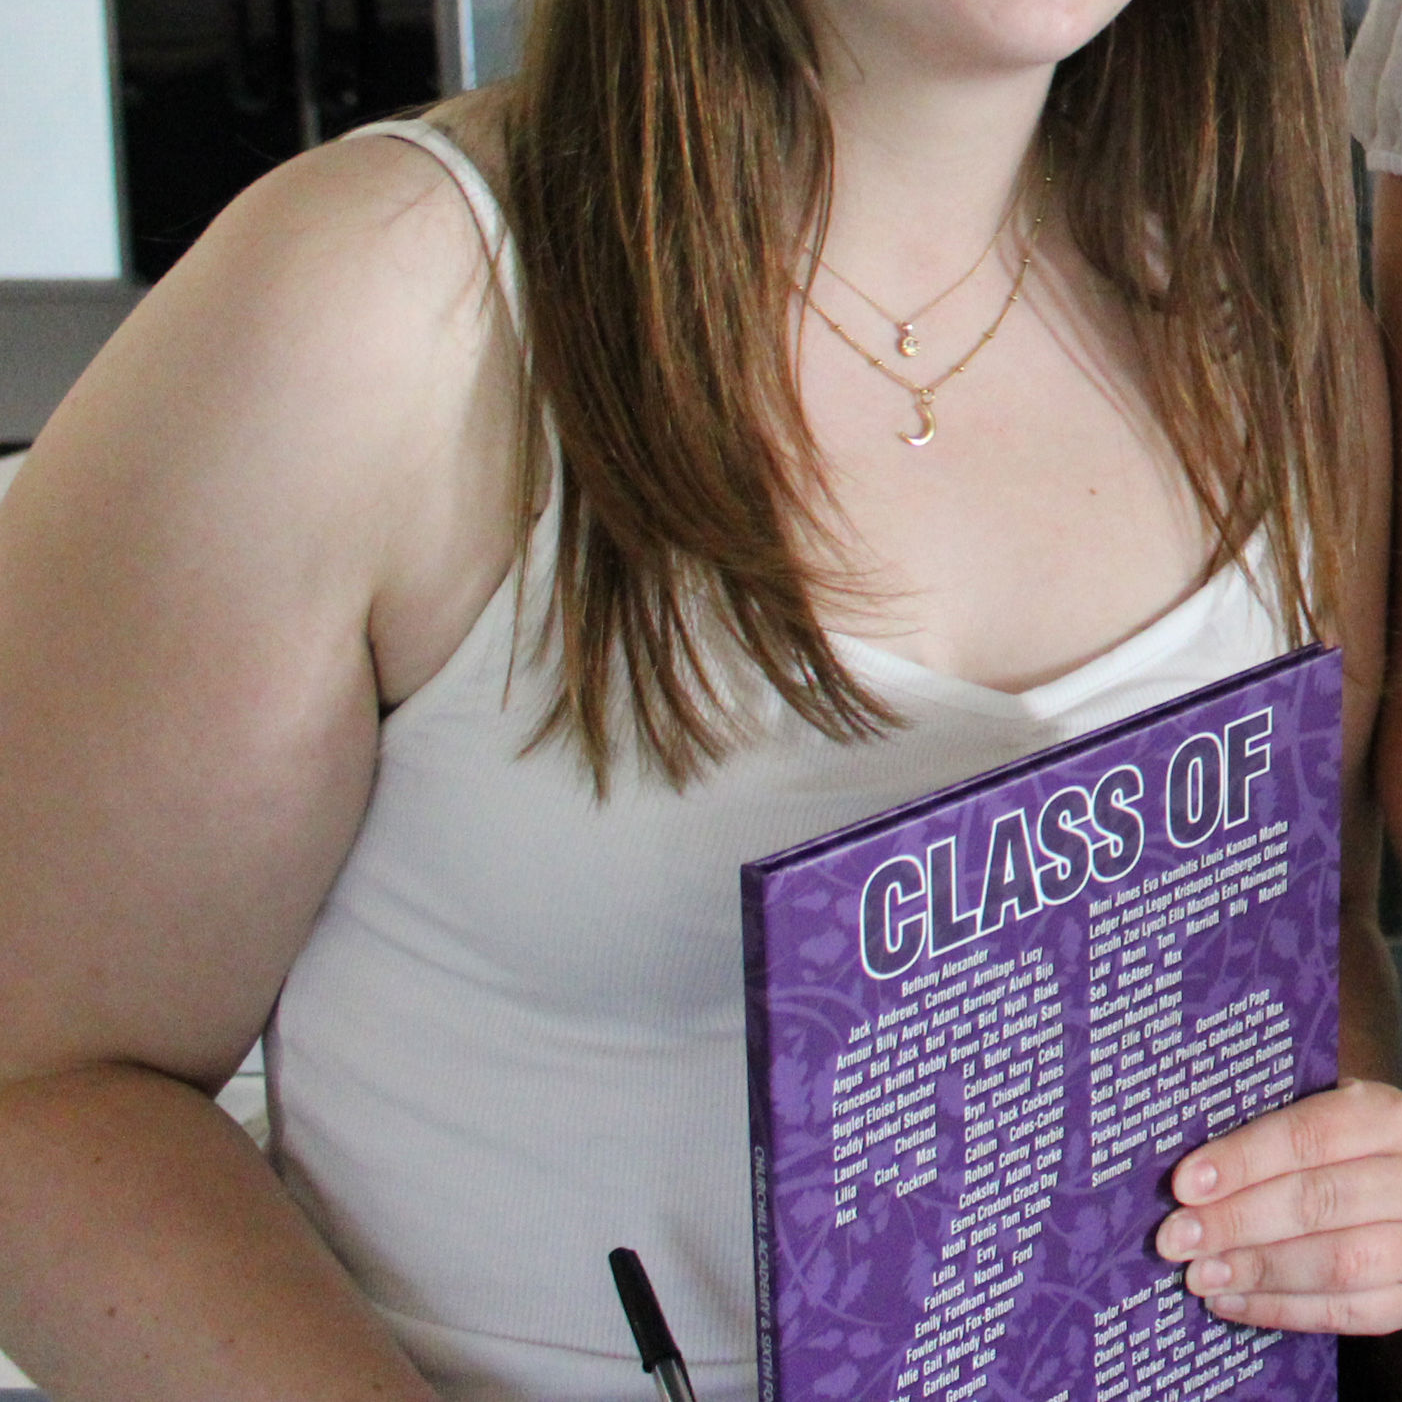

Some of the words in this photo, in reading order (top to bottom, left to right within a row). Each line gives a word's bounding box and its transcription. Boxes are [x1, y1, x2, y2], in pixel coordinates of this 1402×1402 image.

[860, 765, 1143, 979] CLASS
[1166, 707, 1273, 849] OF
[1114, 885, 1140, 906] Jones
[1143, 877, 1158, 894] Eva
[1200, 847, 1223, 868] Louis
[1259, 820, 1288, 841] Martha
[1089, 916, 1120, 939] Ledger
[1121, 905, 1143, 923] Anna
[1263, 840, 1288, 860] Oliver
[1089, 936, 1121, 960] Lincoln
[1123, 927, 1139, 944] Zoe
[1141, 915, 1166, 936] Lynch
[1168, 907, 1184, 924] Ella
[1221, 883, 1238, 899] Erin
[901, 970, 939, 997] Bethany
[941, 948, 988, 979] Alexander
[1089, 961, 1110, 981] Luke
[1121, 945, 1146, 966] Mann
[1156, 932, 1175, 949] Tom
[1229, 898, 1248, 917] Billy
[848, 1019, 870, 1043] Jack
[877, 1001, 918, 1030] Andrews
[924, 980, 966, 1008] Cameron
[973, 958, 1014, 987] Armitage
[1020, 946, 1042, 966] Lucy
[1089, 982, 1107, 1002] Seb
[1164, 949, 1181, 967] Max
[1089, 994, 1130, 1022] McCarthy
[1131, 983, 1153, 1002] Jude
[1159, 990, 1182, 1009] Maya
[832, 1070, 862, 1095] Angus
[870, 1055, 889, 1077] Bird
[896, 1044, 918, 1065] Jack
[925, 1031, 944, 1052] Bird
[952, 1021, 971, 1040] Tom
[978, 1007, 997, 1028] Bird
[1033, 981, 1058, 1003] Blake
[832, 1084, 881, 1117] Francesca
[917, 1054, 947, 1077] Bobby
[950, 1039, 979, 1063] Brown
[982, 1030, 999, 1048] Zac
[1002, 1013, 1037, 1038] Buckley
[1041, 1001, 1061, 1020] Sam
[836, 1044, 872, 1071] Armour
[876, 1033, 897, 1052] Billy
[901, 1019, 928, 1041] Avery
[931, 1005, 959, 1027] Adam
[962, 984, 1005, 1013] Barringer
[1089, 1041, 1118, 1064] Moore
[1121, 1031, 1140, 1048] Ellie
[1090, 1064, 1112, 1084] Wills
[1151, 1030, 1182, 1054] Charlie
[1248, 988, 1269, 1006] Page
[832, 1115, 864, 1140] Bugler
[866, 1101, 895, 1123] Eloise
[896, 1081, 935, 1109] Buncher
[962, 1060, 974, 1079] Ed
[984, 1046, 1011, 1068] Butler
[1020, 1022, 1062, 1051] Benjamin
[1142, 1096, 1171, 1119] Ritchie
[1229, 1055, 1254, 1076] Eloise
[1191, 1055, 1214, 1074] Harry
[833, 1138, 863, 1161] Caddy
[903, 1103, 935, 1127] Steven
[963, 1071, 1003, 1100] Callanan
[1008, 1057, 1033, 1077] Harry
[833, 1157, 867, 1183] Lauren
[963, 1101, 985, 1121] Bryn
[991, 1077, 1030, 1107] Chiswell
[1036, 1064, 1063, 1086] Jones
[873, 1162, 898, 1186] Clark
[916, 1145, 936, 1165] Max
[997, 1105, 1018, 1127] Jack
[1021, 1085, 1063, 1114] Cockayne
[1091, 1149, 1108, 1166] Mia
[1150, 1113, 1178, 1136] Louise
[835, 1206, 857, 1228] Alex
[895, 1167, 937, 1197] Cockram
[964, 1138, 997, 1163] Callum
[1009, 1105, 1064, 1141] Coles-Carter
[958, 1179, 999, 1209] Cooksley
[1005, 1163, 1031, 1185] Adam
[1036, 1148, 1062, 1169] Corke
[964, 1161, 993, 1185] Rohan
[998, 1143, 1030, 1168] Conroy
[1034, 1126, 1064, 1149] Herbie
[1091, 1157, 1131, 1187] Simmons
[1155, 1131, 1182, 1154] Ruben
[1206, 1104, 1235, 1128] Simms
[755, 1145, 769, 1233] CHURCHILL
[950, 1213, 976, 1235] Esme
[1013, 1180, 1038, 1202] Grace
[1040, 1171, 1057, 1189] Day
[932, 1264, 956, 1286] Leila
[1016, 1221, 1041, 1242] Thom
[942, 1237, 965, 1260] Noah
[970, 1223, 996, 1246] Denis
[1001, 1211, 1020, 1229] Tom
[1024, 1195, 1050, 1218] Evans
[758, 1235, 771, 1314] ACADEMY
[914, 1314, 941, 1338] Emily
[944, 1291, 985, 1321] Fordham
[988, 1269, 1023, 1298] Hannah
[923, 1279, 964, 1312] Fairhurst
[973, 1258, 1003, 1286] Naomi
[1012, 1243, 1032, 1265] Ford
[761, 1332, 774, 1378] SIXTH
[896, 1368, 918, 1390] Alfie
[946, 1336, 979, 1362] Melody
[983, 1322, 1005, 1342] Gale
[906, 1338, 937, 1364] Fowler
[939, 1324, 964, 1345] Harry
[965, 1297, 1014, 1331] Fox-Britton
[763, 1378, 775, 1402] FO
[922, 1365, 959, 1397] Garfield
[972, 1348, 995, 1369] Katie
